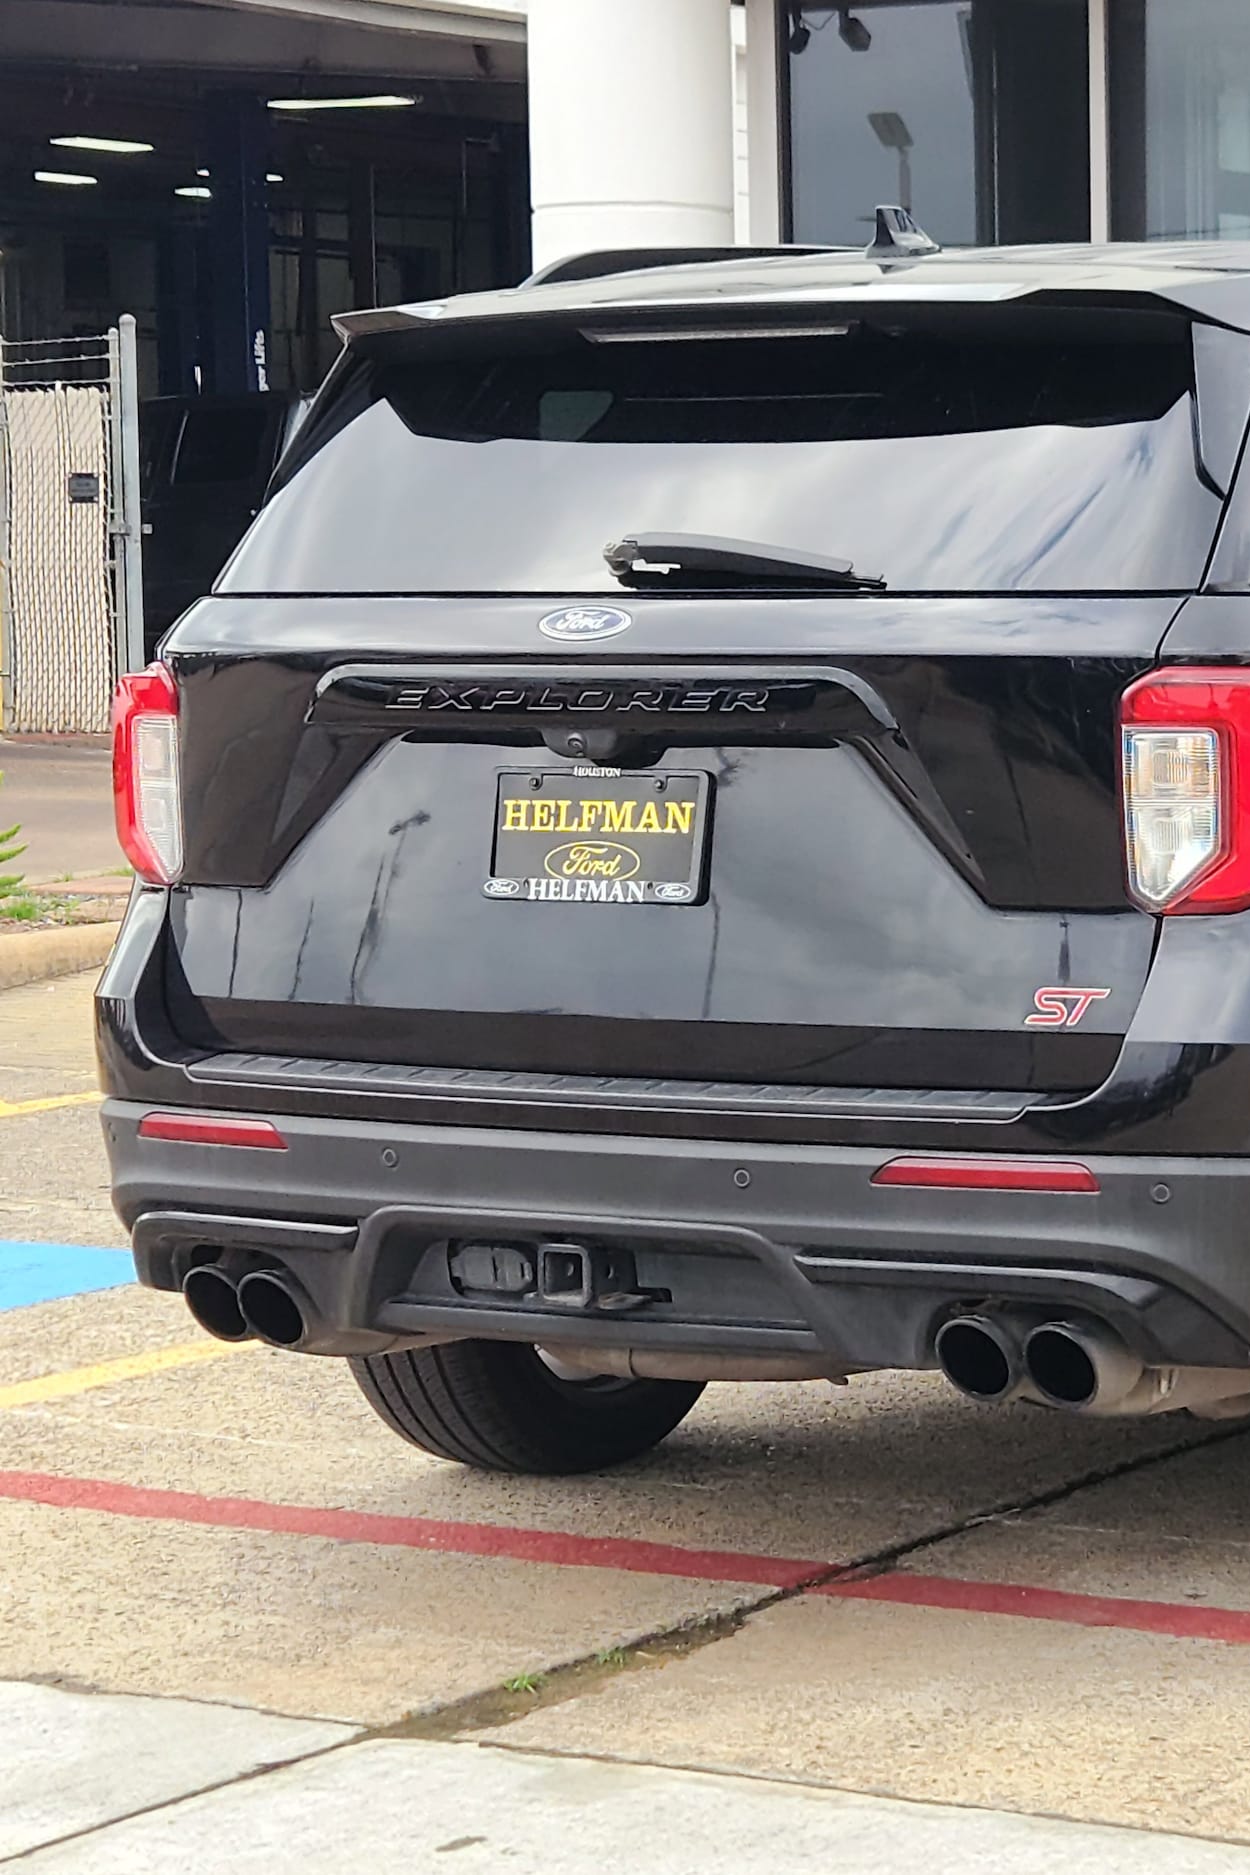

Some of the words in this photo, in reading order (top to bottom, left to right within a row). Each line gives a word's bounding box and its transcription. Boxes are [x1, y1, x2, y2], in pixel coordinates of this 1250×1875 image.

[556, 610, 611, 630] Ford
[384, 685, 770, 713] EXPLORER
[573, 766, 621, 777] HOUSTON
[502, 800, 695, 834] HELFMAN
[562, 846, 622, 876] Ford
[526, 878, 646, 903] HELFMAN
[1024, 986, 1112, 1026] ST
